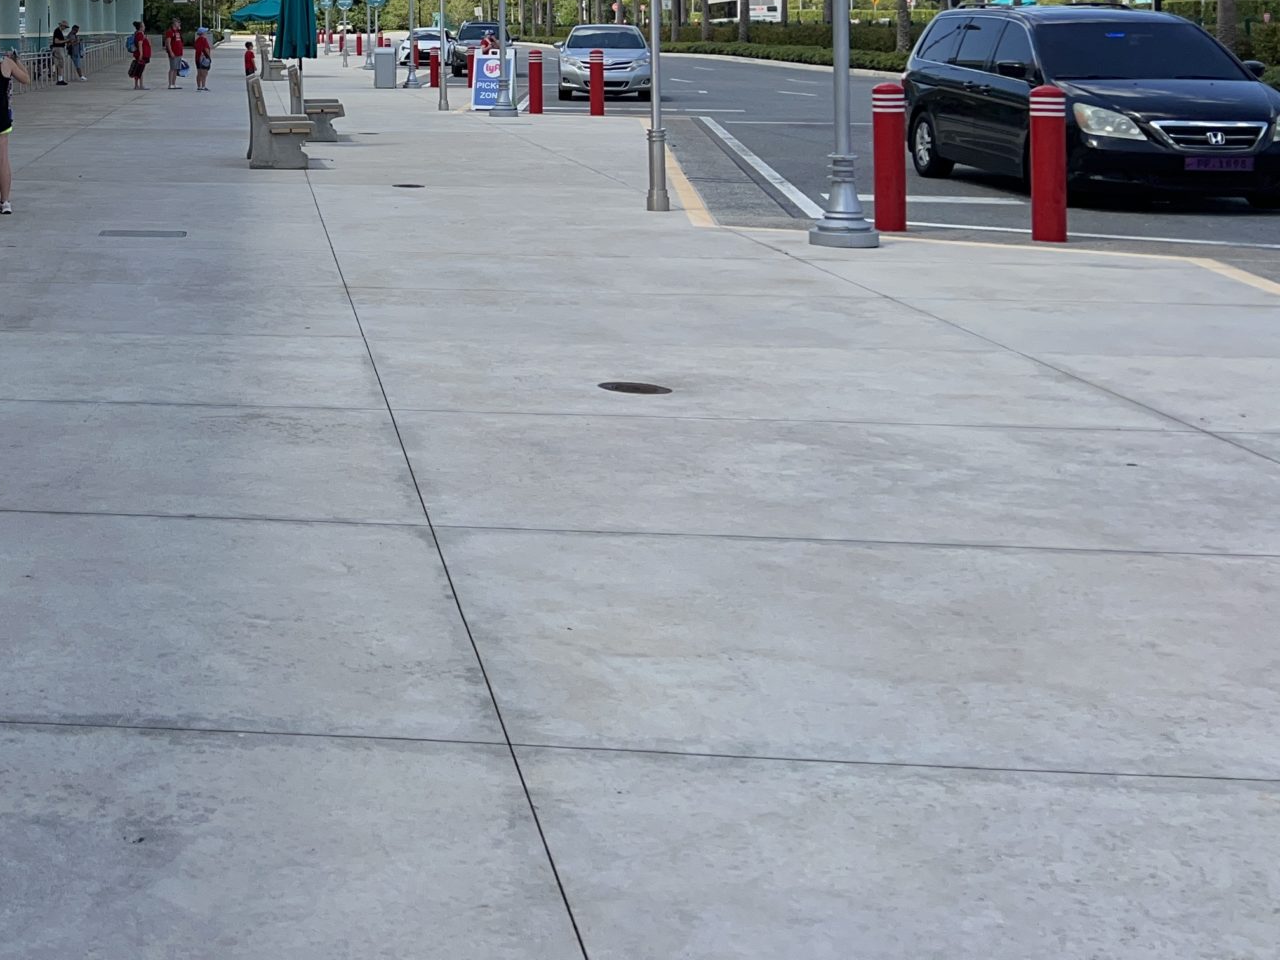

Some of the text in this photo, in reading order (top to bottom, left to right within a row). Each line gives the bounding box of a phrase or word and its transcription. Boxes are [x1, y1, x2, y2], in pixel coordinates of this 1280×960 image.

[485, 63, 501, 74] lyf
[476, 81, 499, 89] PICK
[479, 91, 498, 99] ZON
